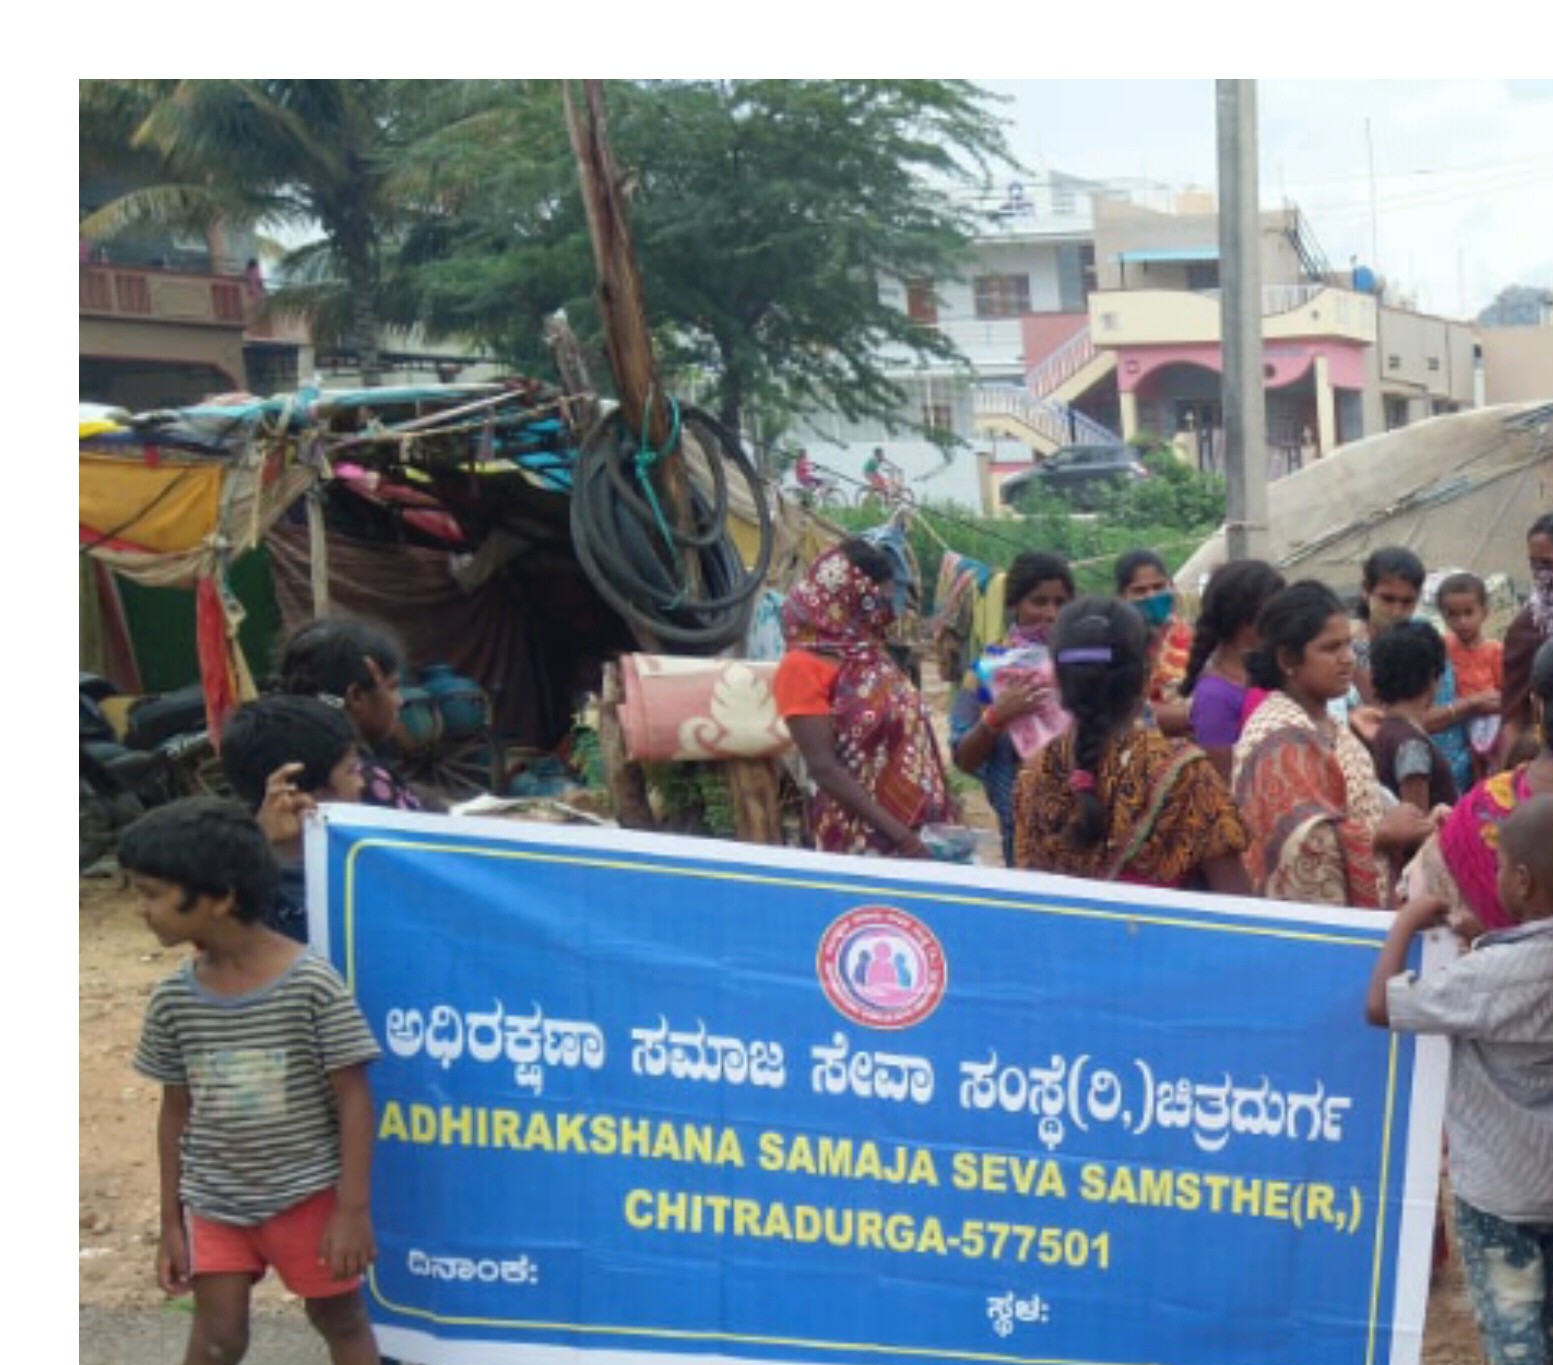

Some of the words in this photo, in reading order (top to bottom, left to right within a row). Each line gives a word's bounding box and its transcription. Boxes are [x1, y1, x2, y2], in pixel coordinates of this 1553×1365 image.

[387, 1004, 604, 1093] ಅಧಿರಕ್ಷಣಾ
[632, 1018, 786, 1088] ಸಮಾಜ
[812, 1032, 934, 1103] ಸೇವಾ
[381, 1103, 744, 1167] ADHIRAKSHANA
[759, 1132, 938, 1186] SAMAJA
[953, 1152, 1066, 1197] SEVA
[1081, 1163, 1361, 1233] SAMSTHE(R,)
[410, 1252, 536, 1282] ದಿನಾಂಕ:
[625, 1189, 1108, 1268] CHITRADURGA-577501
[988, 1293, 1047, 1336] ಸ್ಥಳ:
